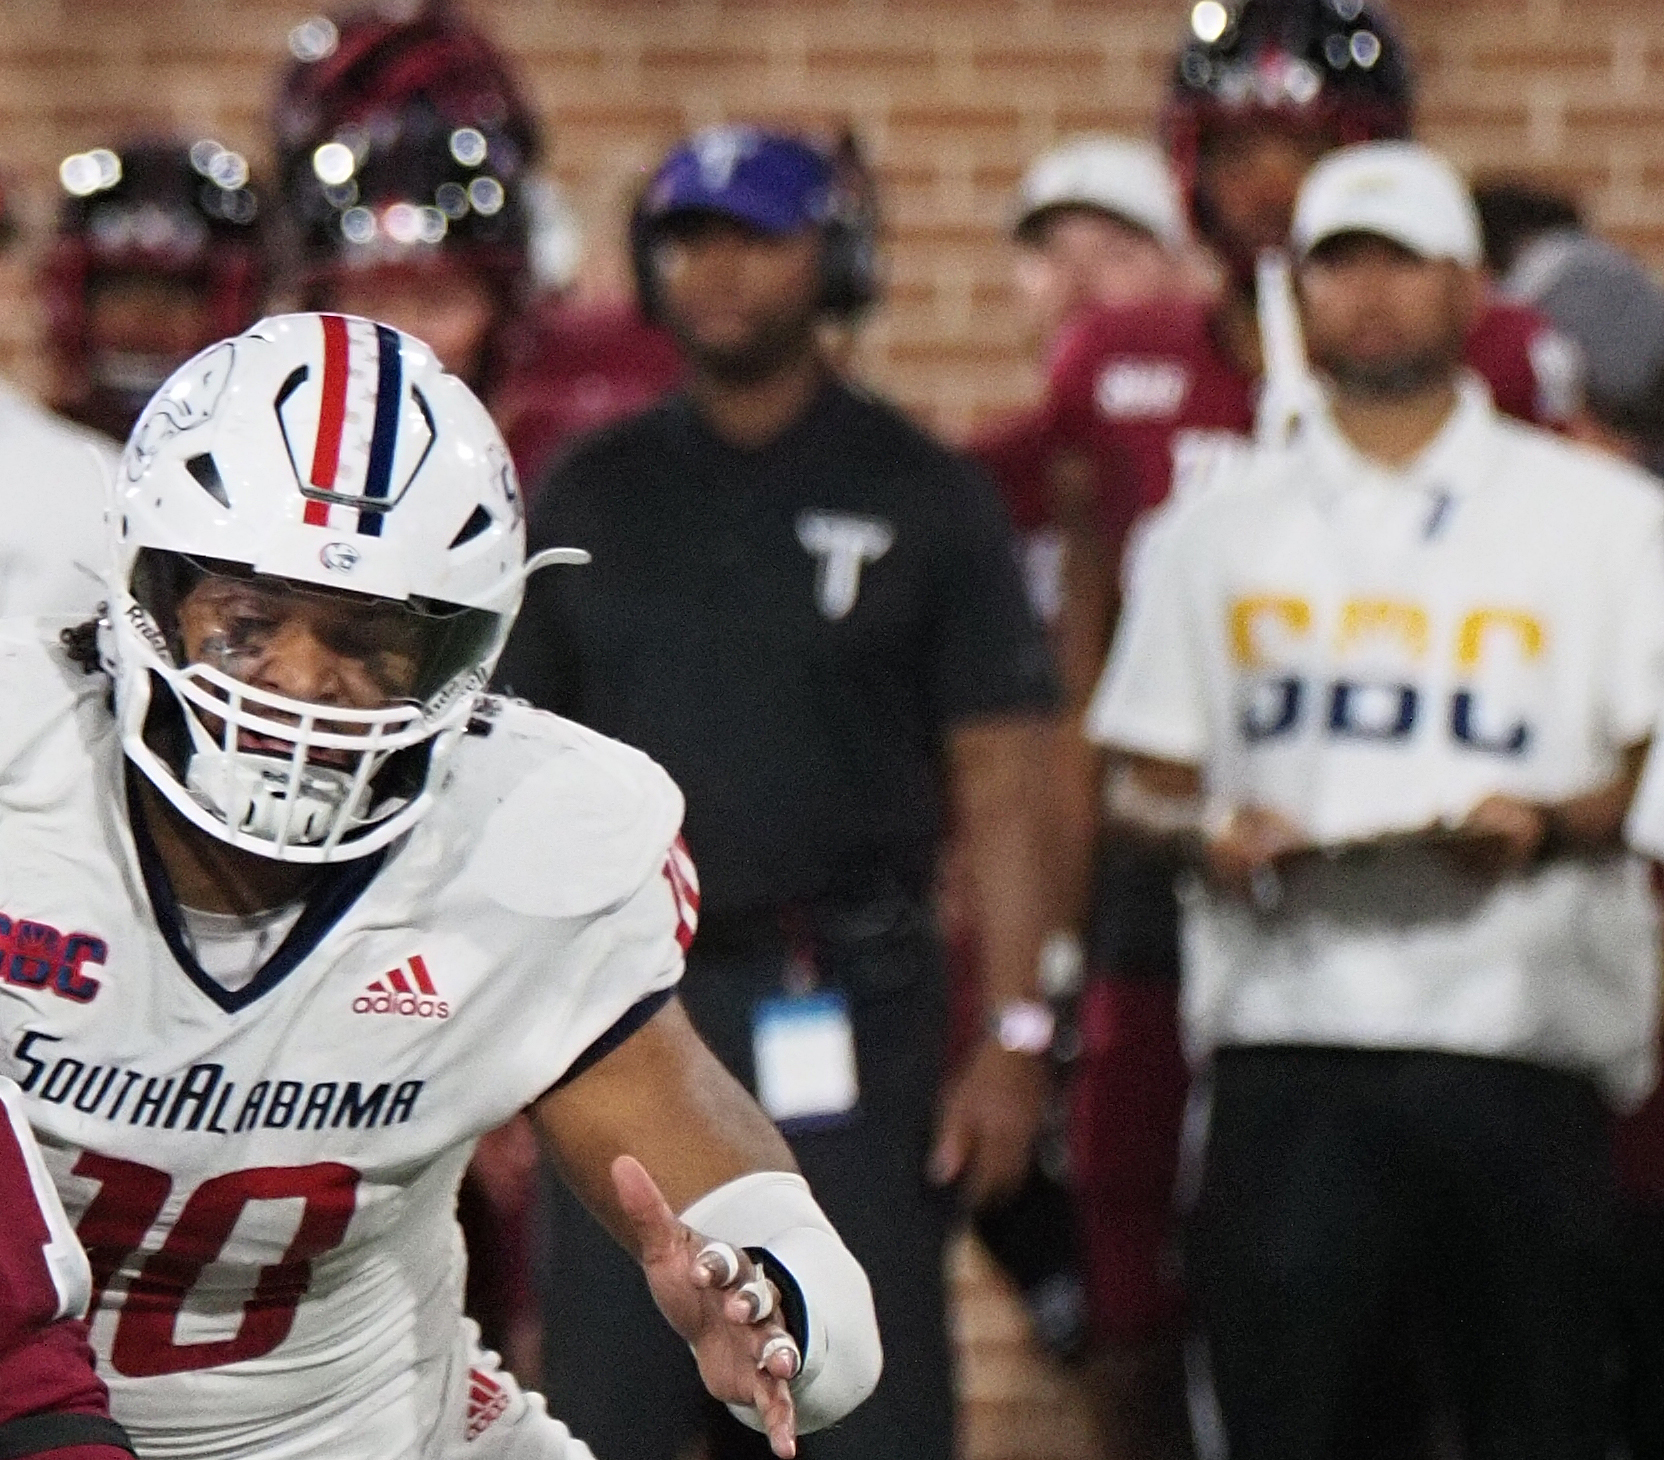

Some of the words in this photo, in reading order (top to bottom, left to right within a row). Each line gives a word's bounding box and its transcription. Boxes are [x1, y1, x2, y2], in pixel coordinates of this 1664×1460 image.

[796, 511, 895, 620] T
[353, 992, 449, 1019] adidas
[71, 1149, 362, 1378] 10
